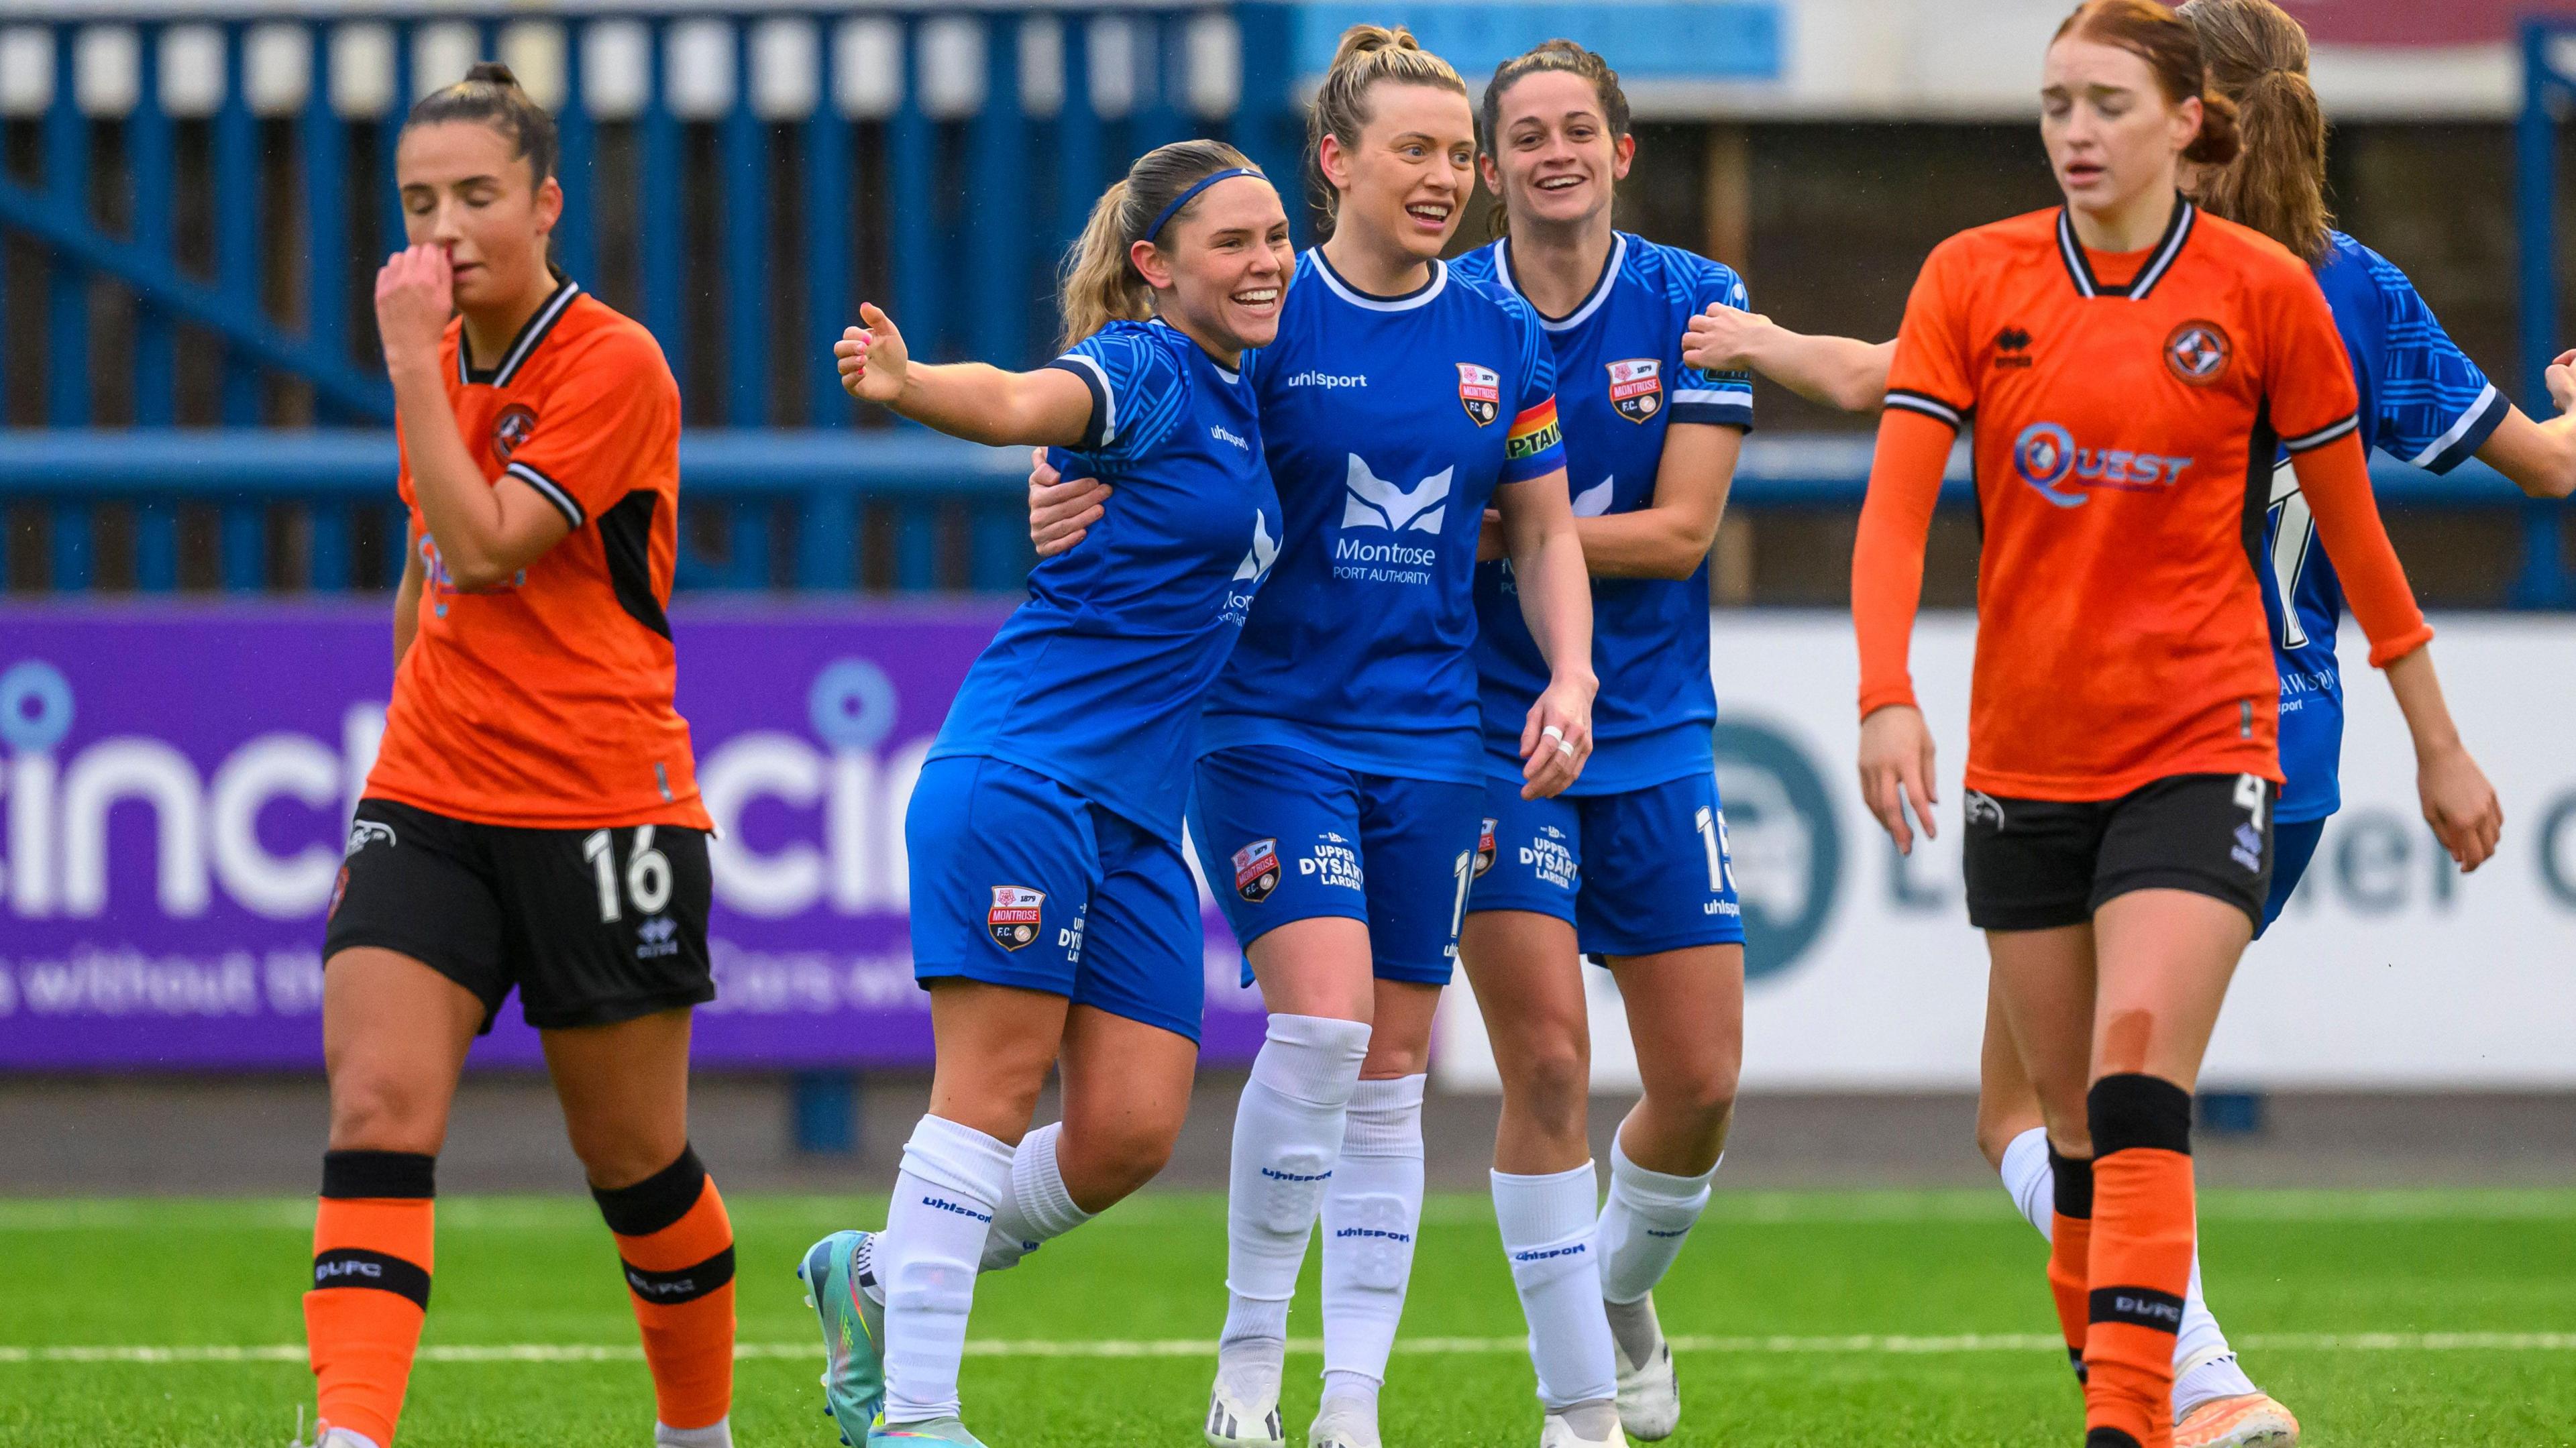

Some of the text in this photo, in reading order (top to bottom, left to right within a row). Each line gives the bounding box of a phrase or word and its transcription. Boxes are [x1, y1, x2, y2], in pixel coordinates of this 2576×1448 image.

[1288, 370, 1368, 389] uhlsport
[1613, 378, 1658, 398] MONTROSE
[1463, 386, 1497, 400] MONTROSE
[1336, 538, 1436, 565] Montrose
[1334, 566, 1431, 586] PORT AUTHORITY
[0, 659, 389, 918] inc
[1315, 845, 1355, 862] UPPER
[1534, 837, 1571, 859] UPPER
[582, 825, 674, 923] 16
[1239, 856, 1275, 883] MONTROSE
[1519, 847, 1578, 881] DYSART
[1321, 874, 1361, 891] LARDER
[1536, 867, 1569, 890] LARDER
[992, 909, 1038, 922] MONTROSE
[997, 927, 1012, 937] F.C.
